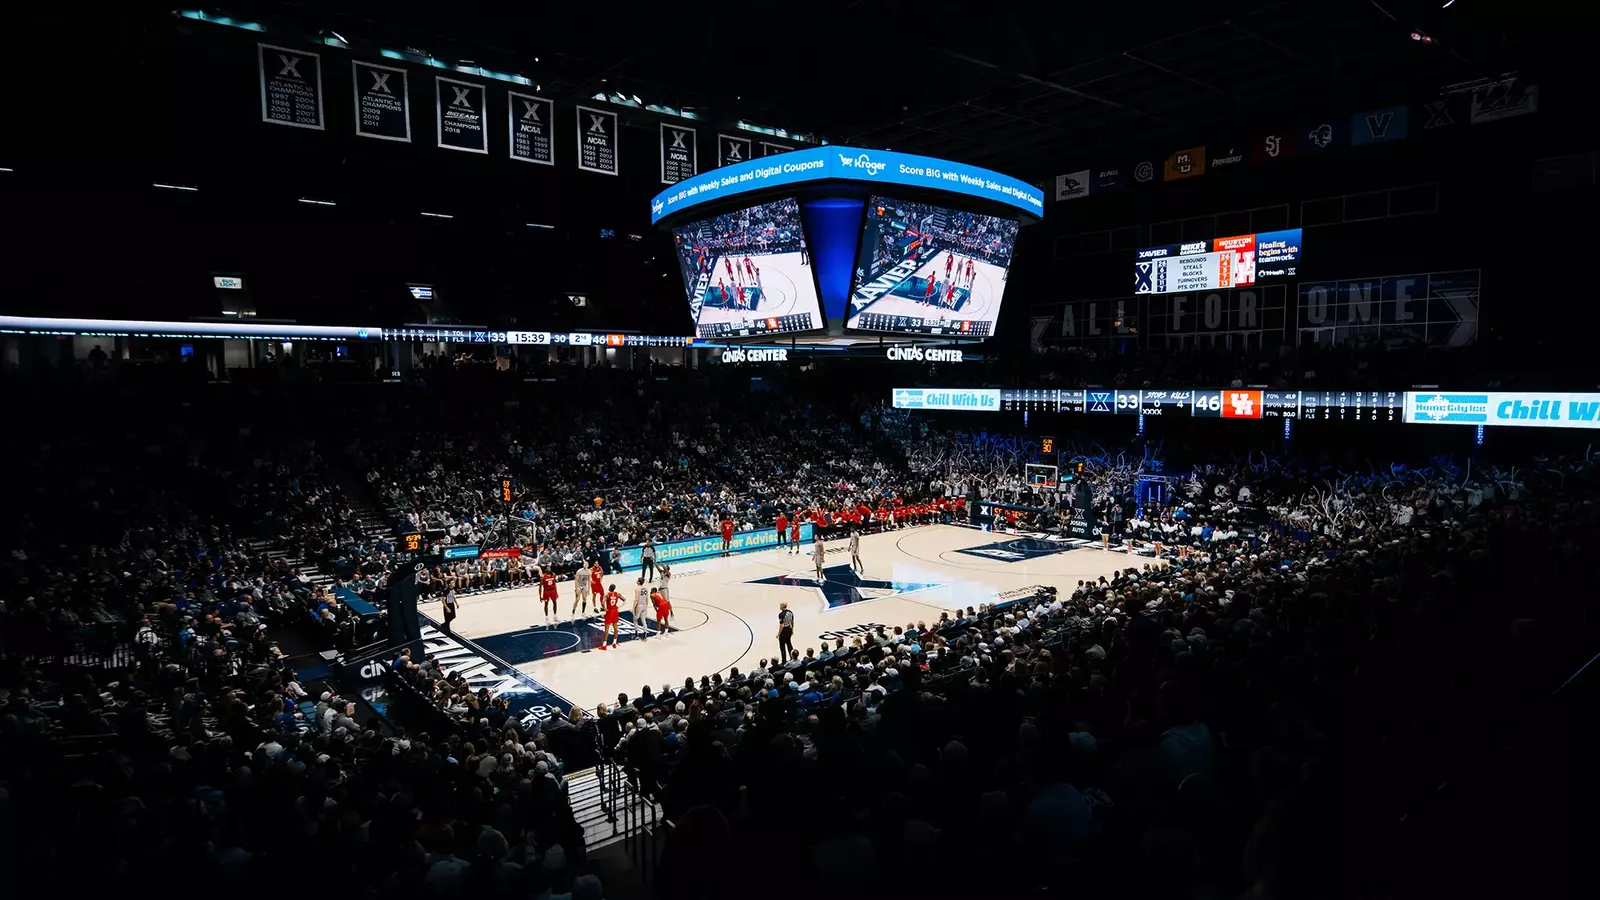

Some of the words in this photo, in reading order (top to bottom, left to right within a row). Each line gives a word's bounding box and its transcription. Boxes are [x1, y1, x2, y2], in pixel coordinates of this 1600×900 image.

[278, 54, 302, 78] X
[371, 70, 392, 93] X
[269, 86, 314, 97] CHAMPIONS
[452, 86, 472, 107] X
[362, 95, 393, 105] ATLANTIC
[362, 100, 402, 112] CHAMPIONS
[362, 106, 381, 115] 2009
[523, 100, 541, 121] X
[363, 113, 380, 121] 2010
[363, 119, 379, 127] 2011
[444, 120, 481, 131] CHAMPIONS
[589, 113, 606, 133] X
[444, 126, 461, 134] 2018
[520, 124, 541, 135] NCAA
[587, 136, 607, 146] NCAA
[672, 130, 687, 149] X
[854, 154, 886, 175] Kroger
[668, 195, 679, 205] Score
[679, 190, 688, 200] BIG
[687, 187, 699, 197] with
[699, 179, 720, 194] Weekly
[721, 176, 739, 188] Sales
[740, 173, 755, 184] and
[755, 164, 783, 181] Digital
[783, 158, 825, 176] Coupons
[899, 164, 925, 177] Score
[926, 168, 941, 180] BIG
[942, 171, 960, 183] with
[960, 174, 985, 191] Weekly
[985, 180, 1002, 193] Sales
[1001, 186, 1013, 196] and
[1012, 186, 1027, 203] Digital
[1219, 237, 1252, 248] HOUSTON
[1259, 241, 1286, 250] Healing
[1139, 249, 1168, 259] XAVIER
[1259, 248, 1281, 257] begins
[1282, 246, 1298, 255] with
[1179, 257, 1207, 265] REBOUNDS
[1258, 254, 1295, 263] teamwork.
[1177, 276, 1208, 284] TURNOVERS
[1062, 300, 1130, 338] ALL
[1173, 290, 1257, 331] FOR
[1308, 278, 1417, 325] ONE
[723, 323, 731, 332] 33
[757, 320, 766, 329] 46
[911, 318, 921, 327] 33
[952, 321, 961, 330] 46
[491, 332, 506, 343] 33
[515, 333, 545, 343] 15:39
[554, 334, 567, 343] 30
[592, 335, 606, 344] 46
[747, 349, 788, 362] CENTER
[887, 344, 923, 361] CINTAS
[925, 349, 962, 363] CENTER
[927, 393, 951, 407] Chill
[952, 393, 978, 407] With
[981, 394, 995, 407] Us
[1145, 391, 1167, 399] STOPS
[1171, 391, 1190, 400] KILLS
[1117, 395, 1138, 409] 33
[1177, 400, 1184, 408] 4
[1195, 395, 1221, 411] 46
[1447, 404, 1468, 413] City
[1469, 404, 1486, 412] Ice
[1497, 400, 1562, 421] Chill
[1042, 444, 1052, 453] 30
[1070, 520, 1088, 528] JOSEPH
[1071, 526, 1085, 534] AUTO
[405, 534, 422, 542] 15:39
[407, 541, 419, 550] 30
